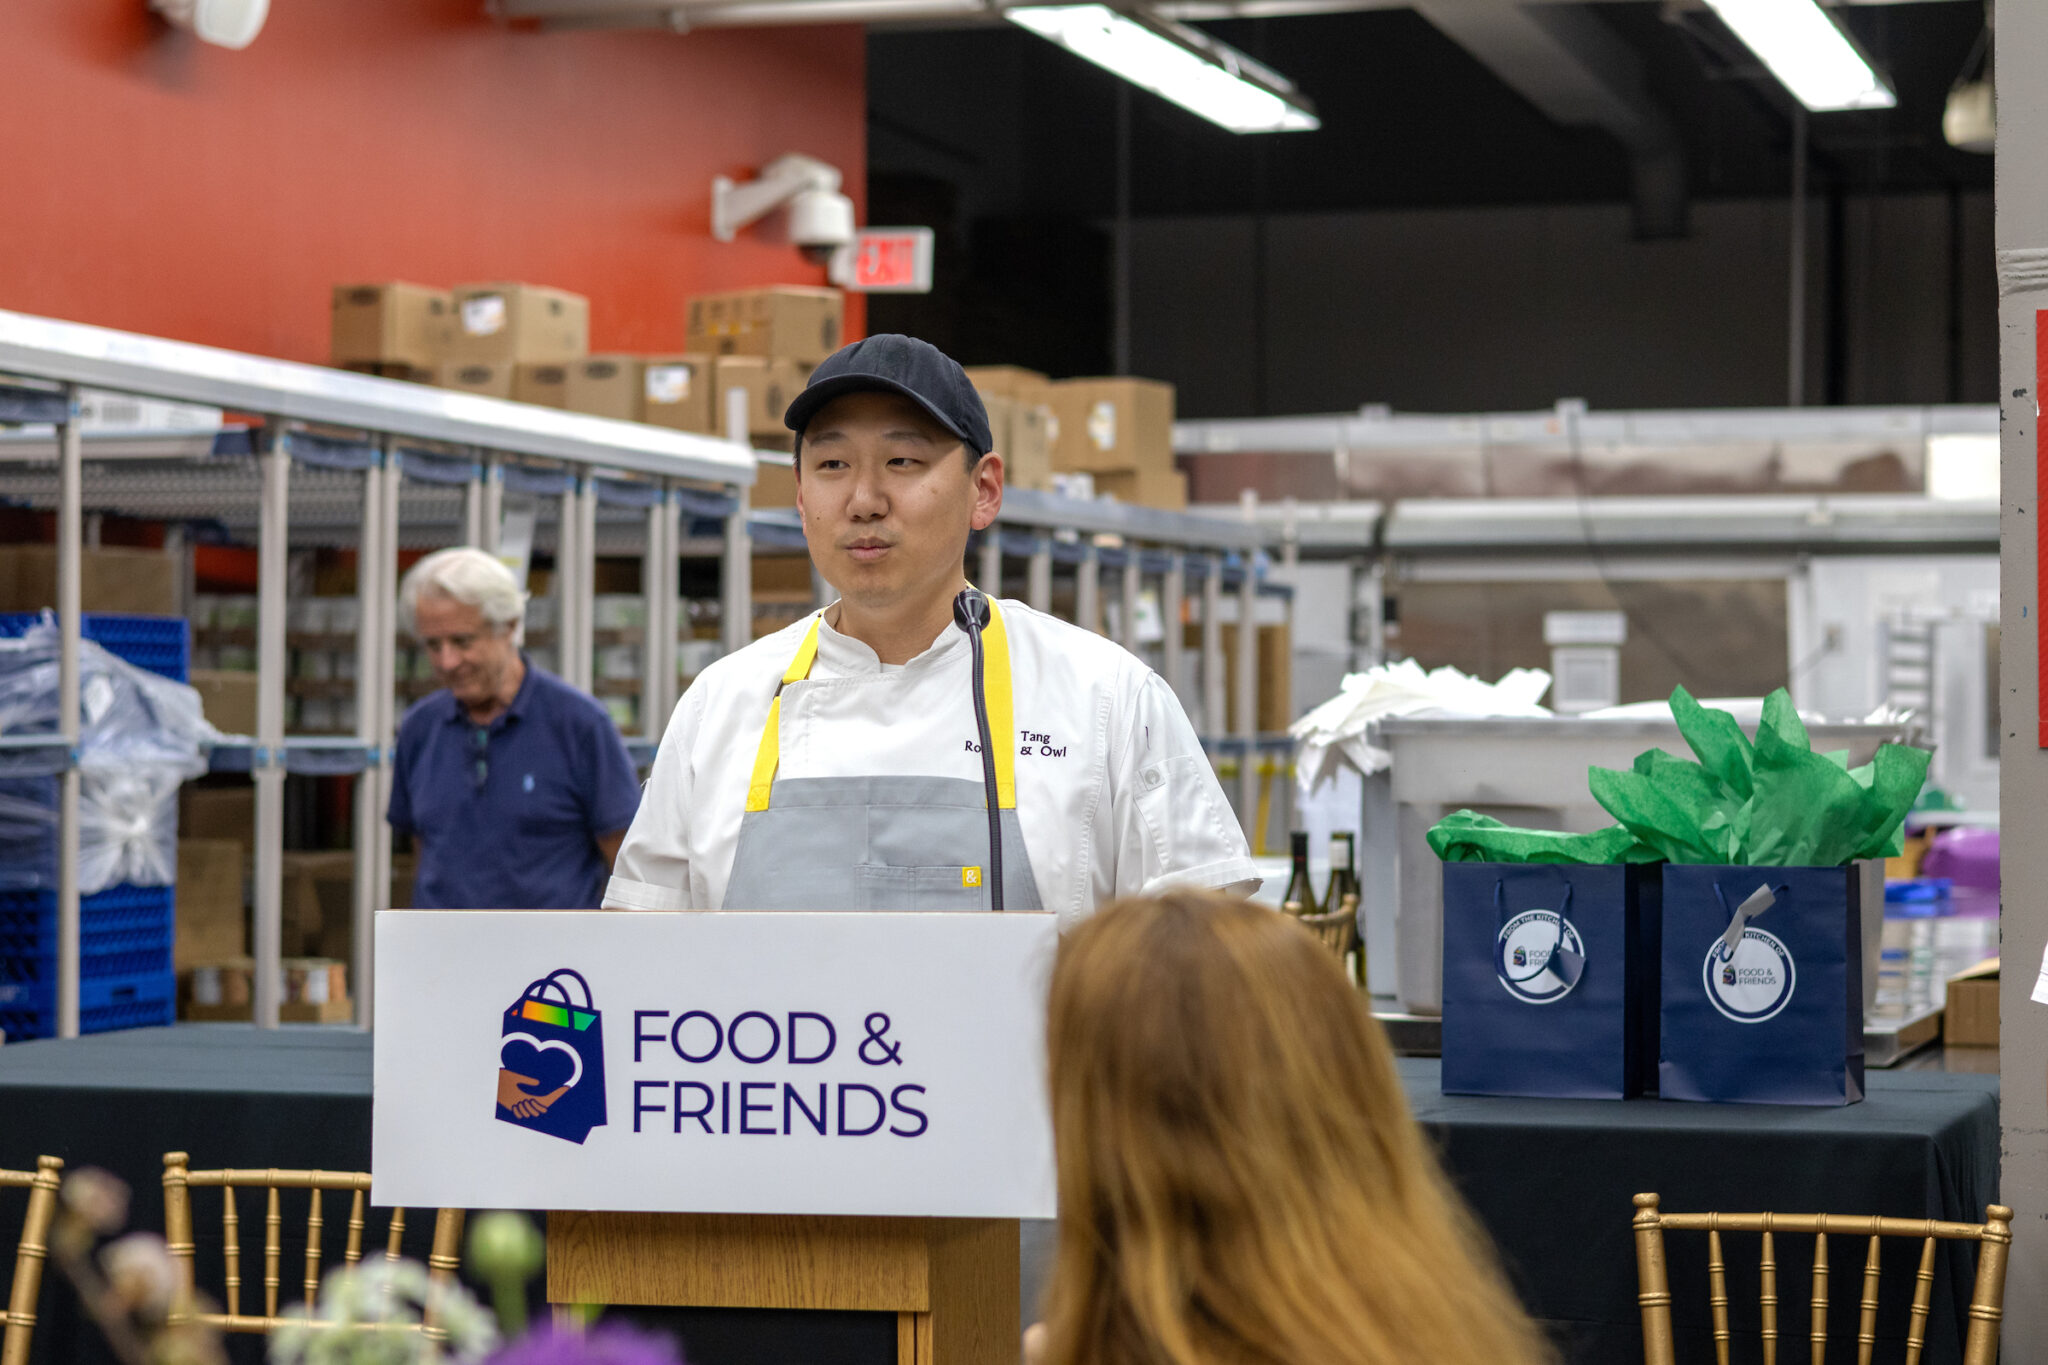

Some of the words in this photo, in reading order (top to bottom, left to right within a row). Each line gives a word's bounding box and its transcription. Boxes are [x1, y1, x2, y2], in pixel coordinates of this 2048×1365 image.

[857, 238, 912, 284] EXIT
[1020, 730, 1051, 744] Tang
[1020, 746, 1032, 756] &
[1040, 745, 1067, 758] Owl
[1503, 920, 1521, 939] FROM
[1521, 914, 1535, 923] THE
[1745, 932, 1775, 948] KITCHEN
[1738, 968, 1765, 976] FOOD
[1738, 977, 1777, 985] FRIENDS
[634, 1010, 837, 1064] FOOD
[858, 1012, 903, 1066] &
[633, 1080, 929, 1138] FRIENDS
